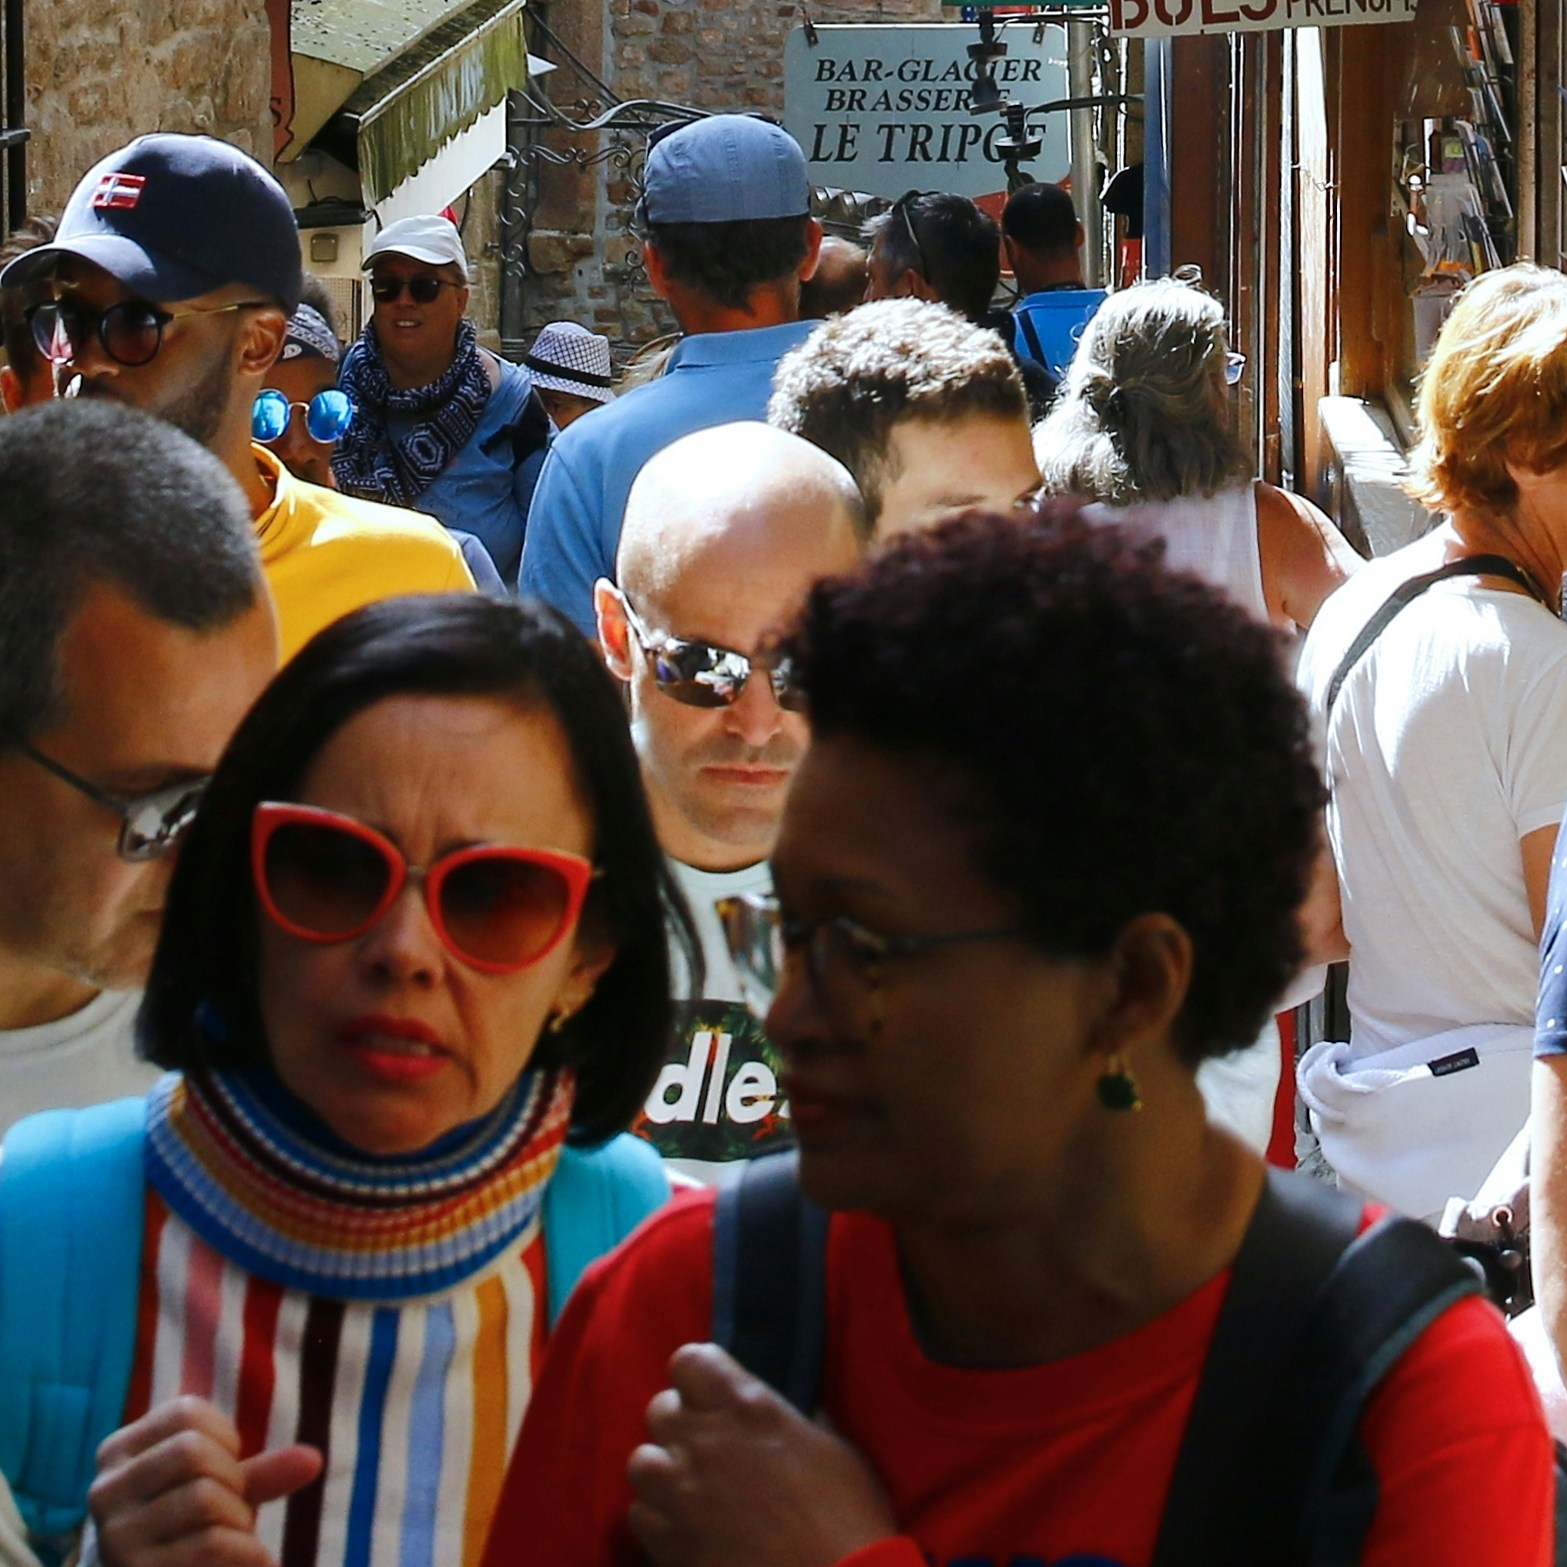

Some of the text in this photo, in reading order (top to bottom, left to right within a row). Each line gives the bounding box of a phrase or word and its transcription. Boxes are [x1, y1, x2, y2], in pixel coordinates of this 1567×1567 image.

[824, 88, 1011, 112] BRASSERE
[809, 123, 862, 163] LE
[643, 1030, 790, 1124] dle
